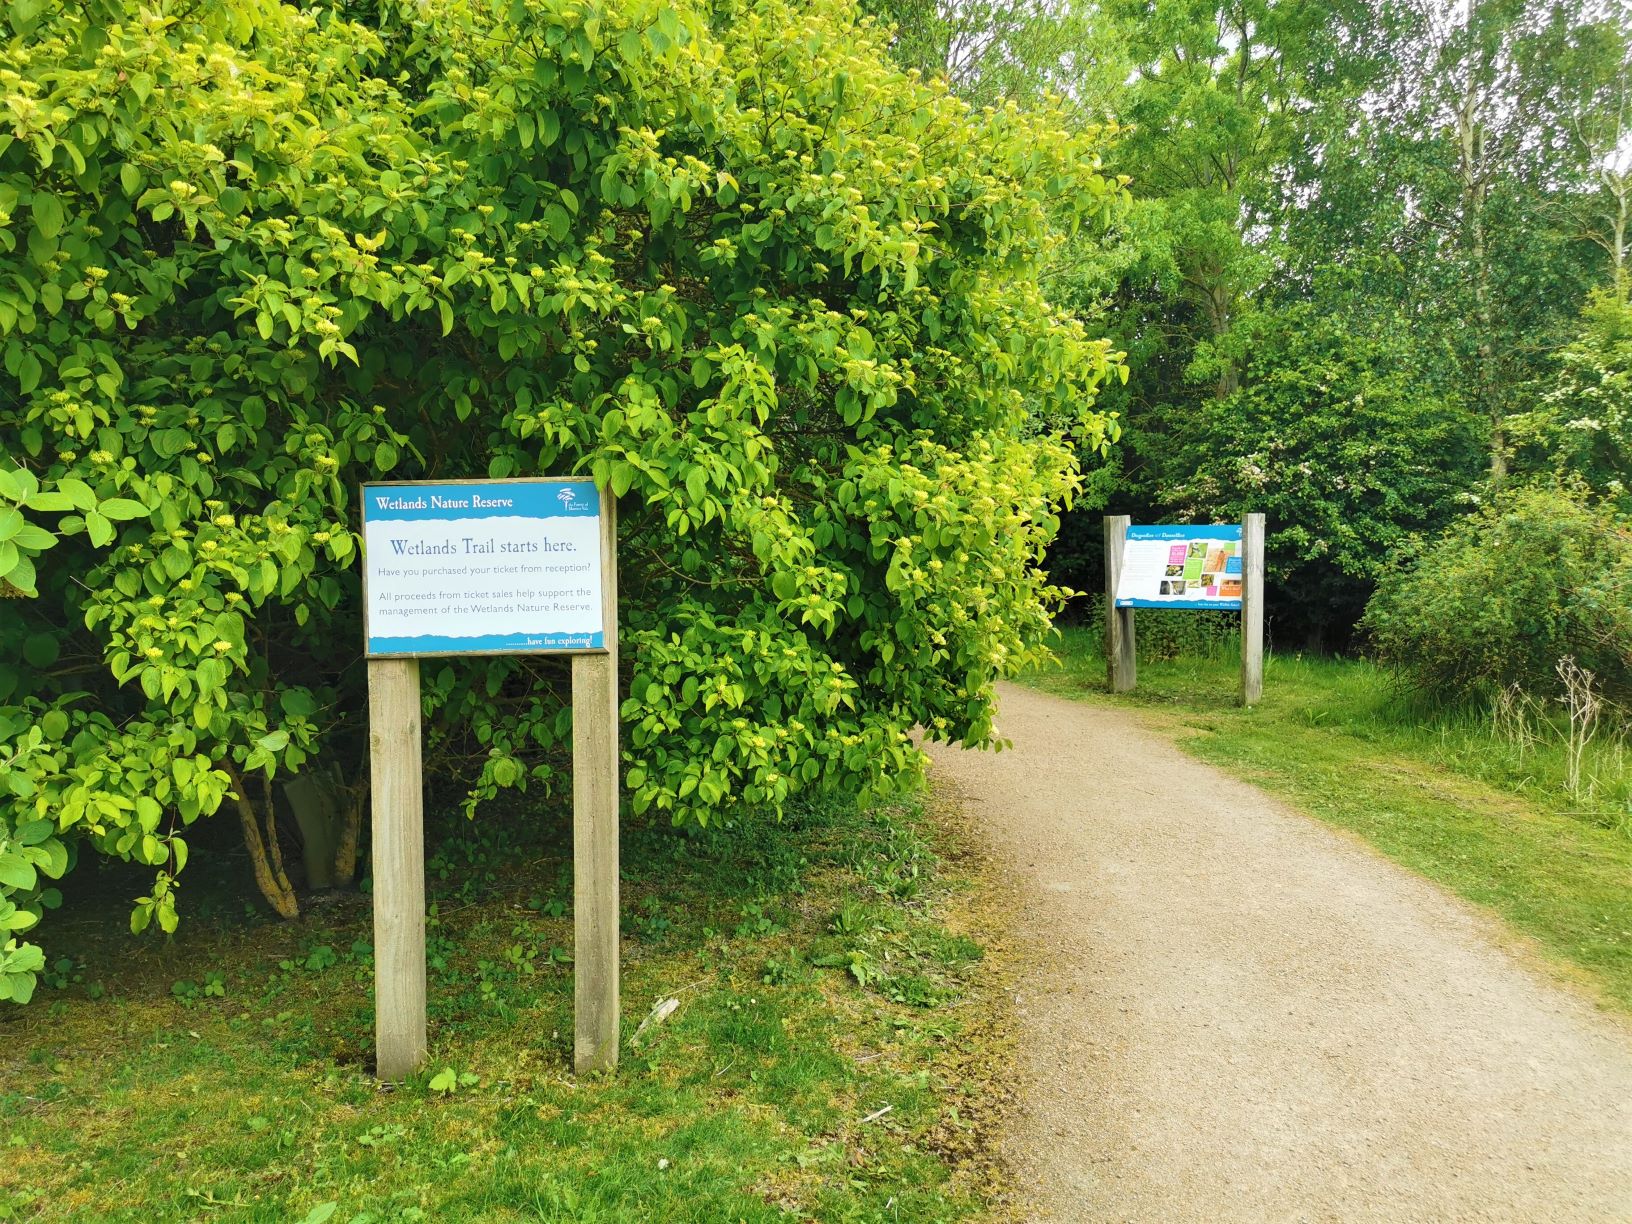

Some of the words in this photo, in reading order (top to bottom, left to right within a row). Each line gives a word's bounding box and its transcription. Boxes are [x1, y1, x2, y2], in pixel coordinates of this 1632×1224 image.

[376, 497, 427, 509] Wetlands
[431, 496, 469, 509] Nature
[473, 495, 513, 507] Reserve
[391, 540, 457, 556] Wetlands
[462, 538, 494, 554] Trail
[501, 539, 538, 553] starts
[544, 537, 577, 552] here.
[378, 568, 400, 576] Have
[403, 569, 419, 577] you
[423, 567, 467, 576] purchased
[470, 567, 490, 575] your
[494, 565, 518, 574] ticket
[521, 565, 541, 573] from
[545, 563, 591, 574] reception?
[379, 592, 392, 601] All
[395, 592, 436, 602] proceeds
[439, 591, 460, 599] from
[464, 590, 489, 599] ticket
[492, 589, 513, 598] sales
[516, 589, 535, 599] help
[539, 589, 573, 598] support
[577, 588, 591, 596] the
[379, 606, 437, 617] management
[441, 606, 450, 614] of
[454, 605, 469, 613] the
[470, 604, 514, 613] Wetlands
[517, 603, 550, 612] Nature
[553, 603, 592, 611] Reserve.
[544, 637, 555, 645] fun
[558, 636, 592, 647] exploring!
